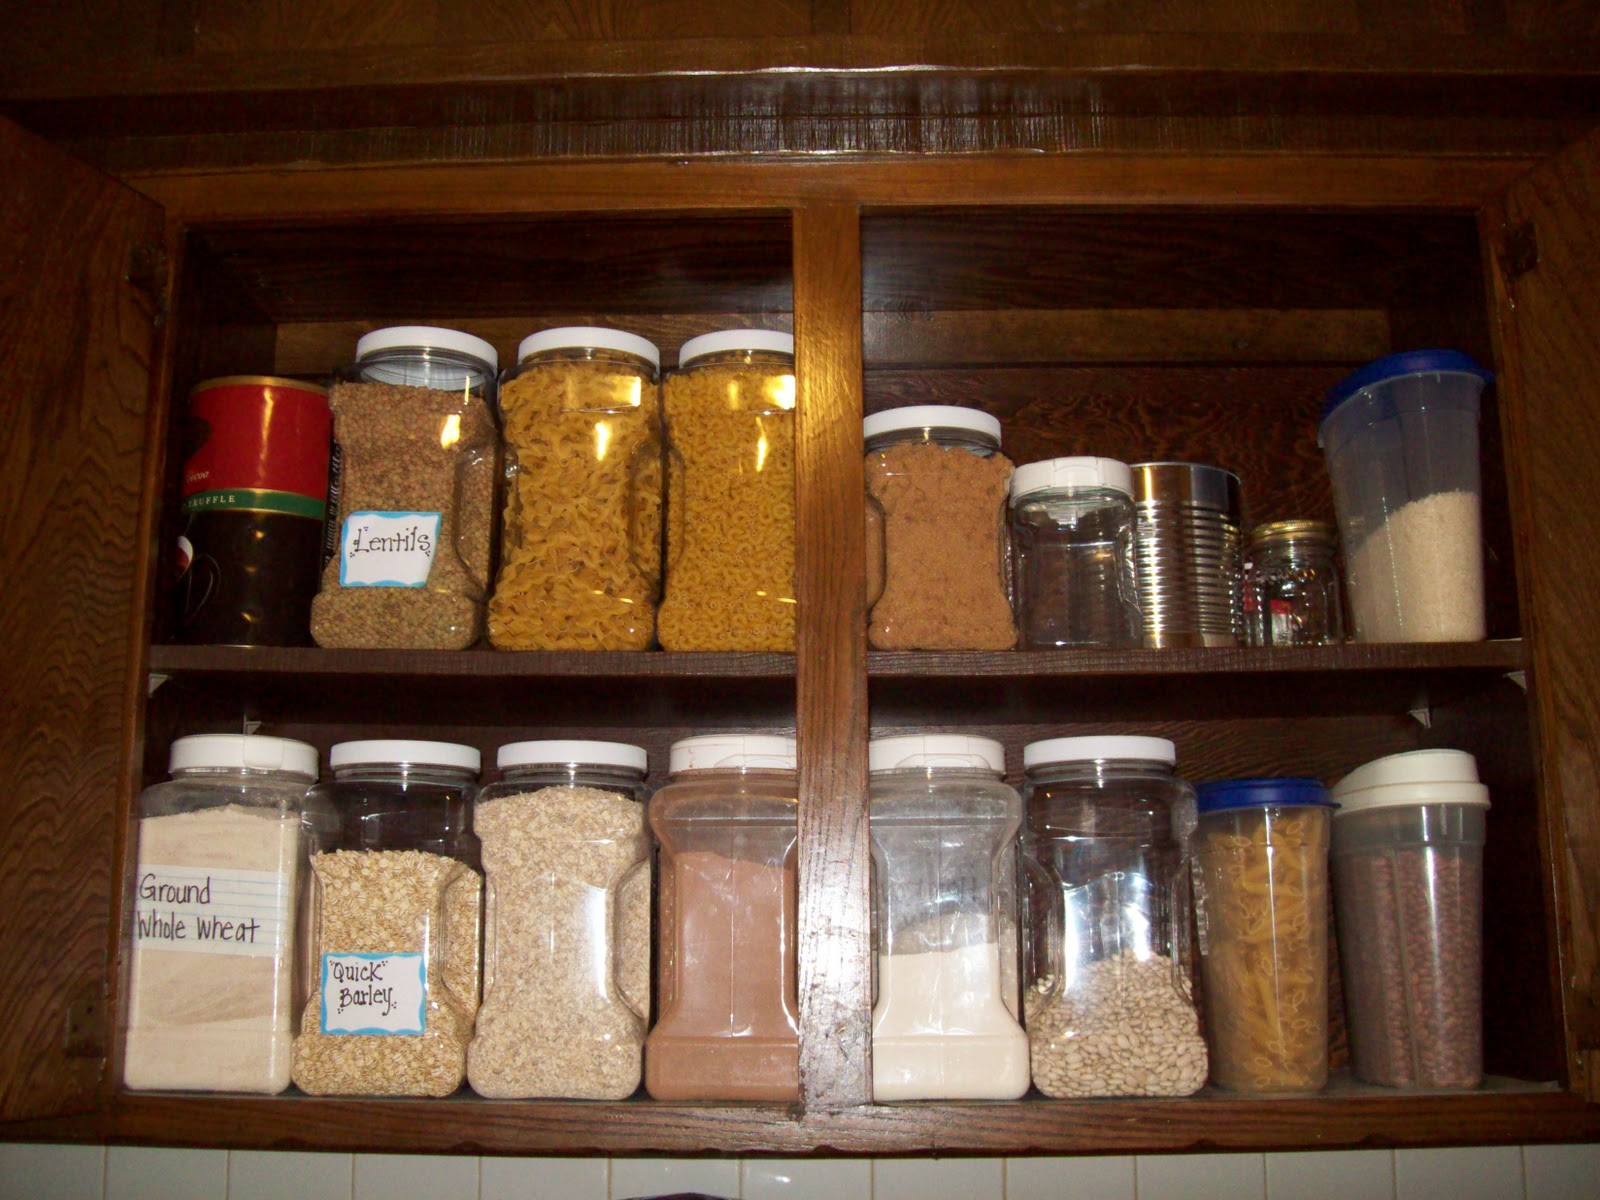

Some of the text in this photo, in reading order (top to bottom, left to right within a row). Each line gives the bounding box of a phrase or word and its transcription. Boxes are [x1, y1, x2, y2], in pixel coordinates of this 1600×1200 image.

[188, 495, 236, 508] TRUFFLE
[353, 526, 431, 553] Lentils
[138, 873, 211, 905] Ground
[136, 909, 260, 943] Whole Wheat
[339, 986, 394, 1016] Barley
